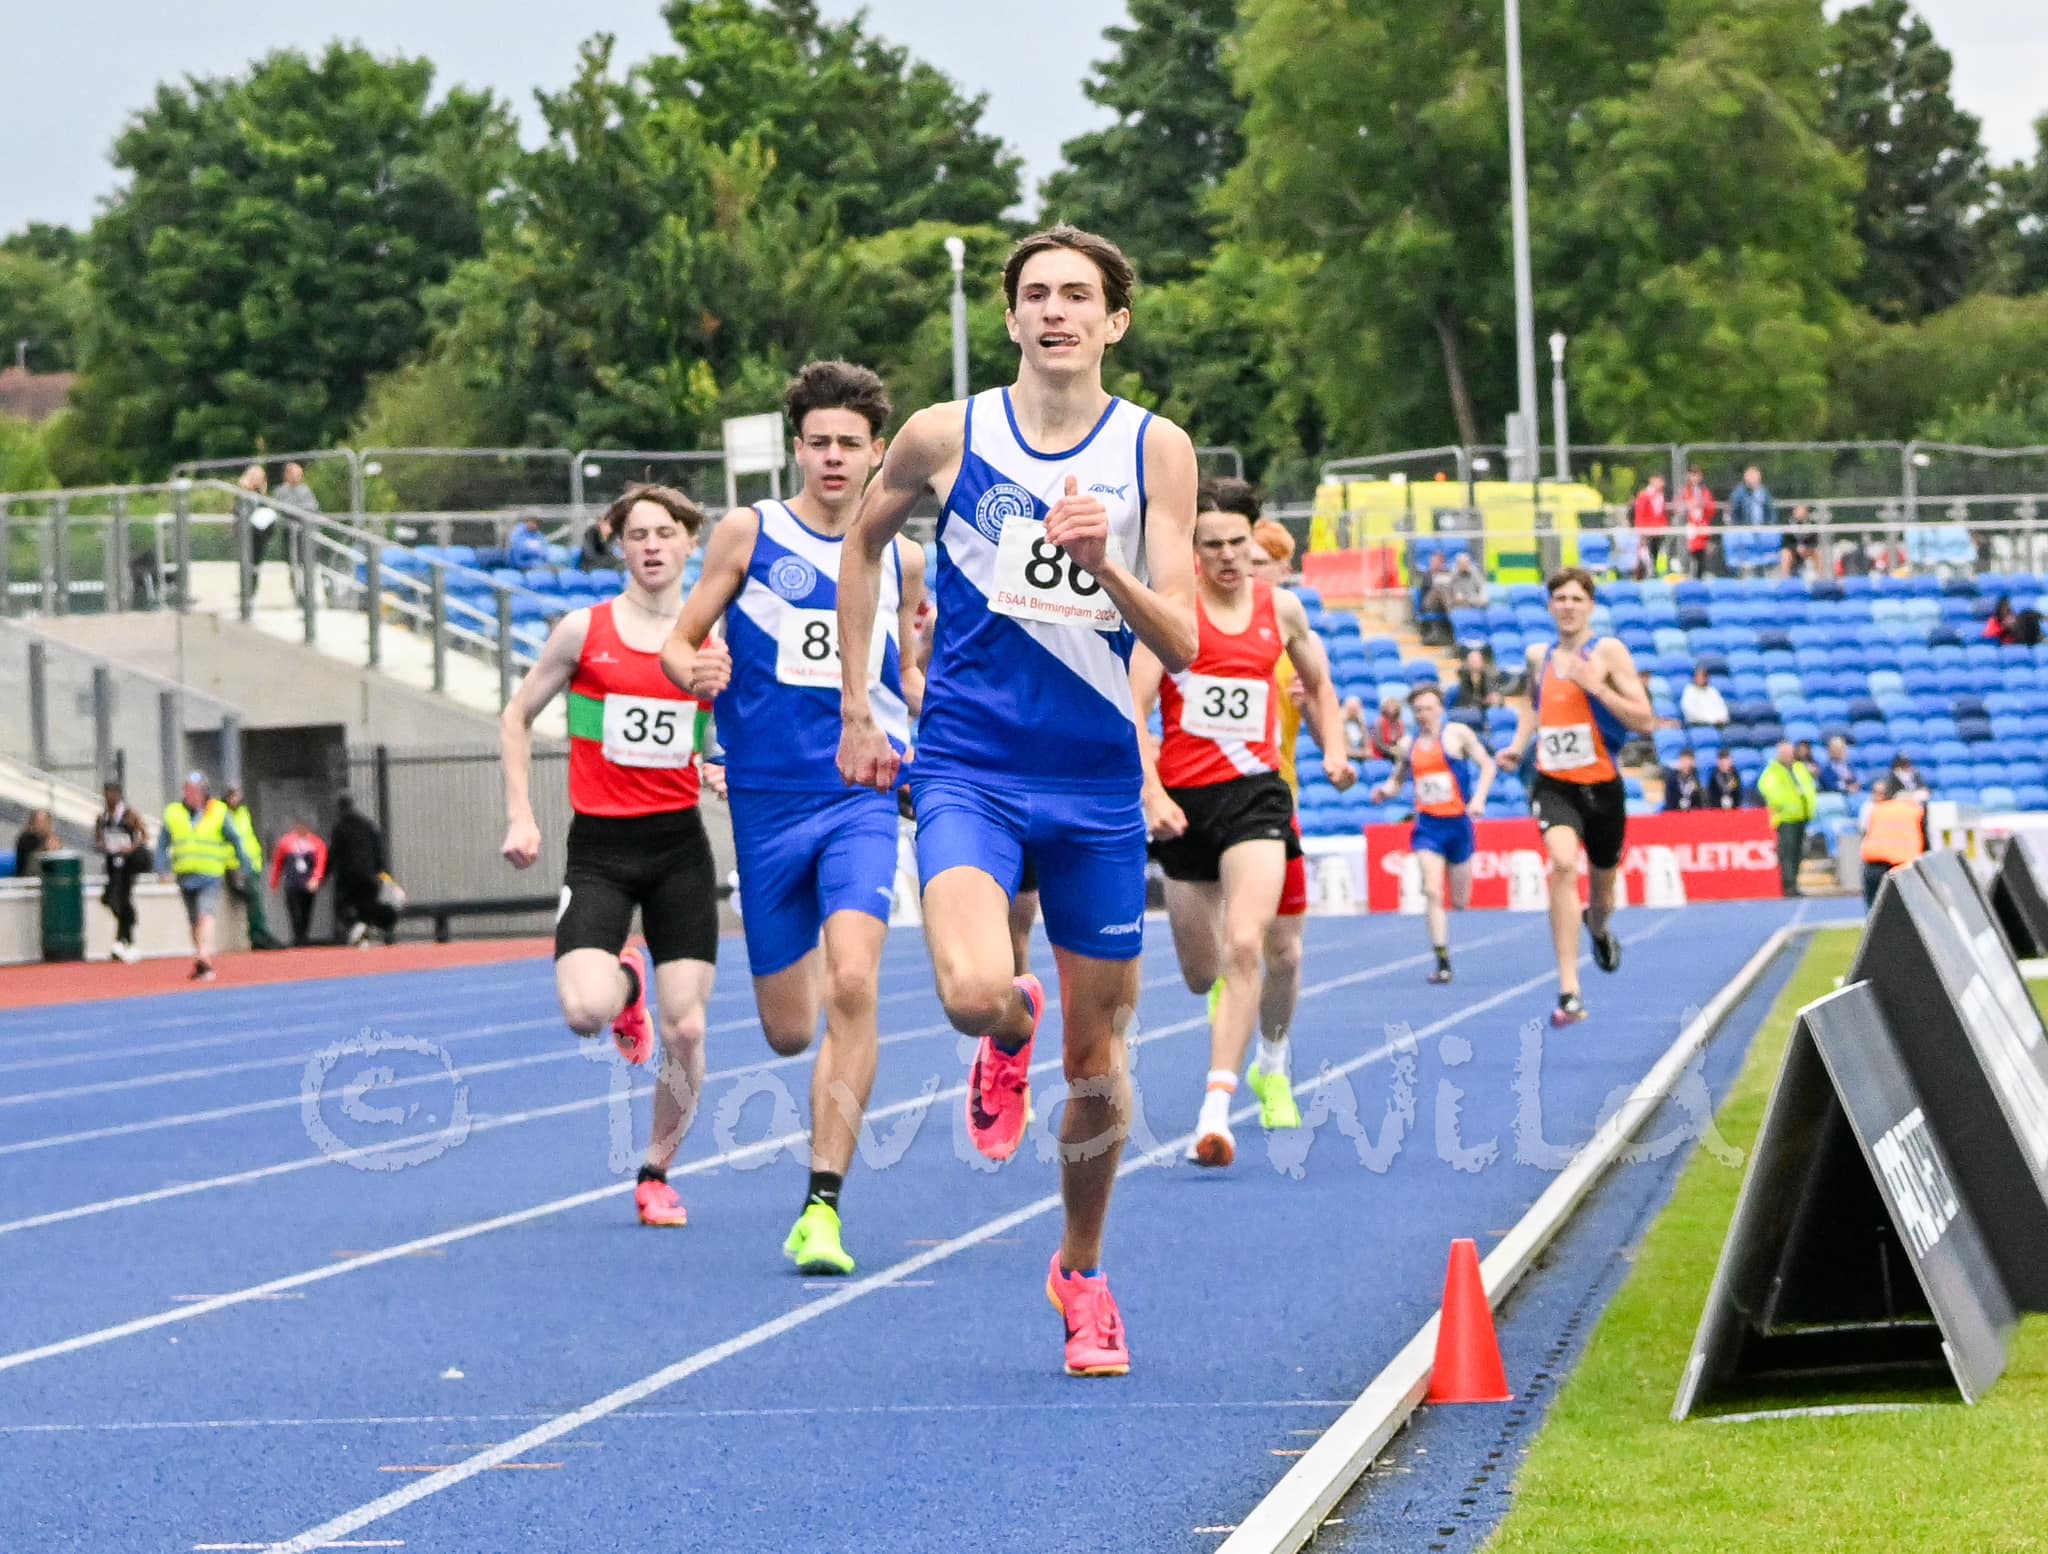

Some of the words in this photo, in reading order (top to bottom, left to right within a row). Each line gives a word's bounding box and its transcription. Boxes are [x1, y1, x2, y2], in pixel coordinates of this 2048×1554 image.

[998, 591, 1026, 607] ESAA
[1030, 597, 1092, 619] Birmingham
[1094, 610, 1118, 622] 2024
[802, 621, 840, 660] 8
[1203, 686, 1249, 719] 33
[623, 707, 677, 745] 35
[1545, 731, 1579, 756] 32
[1623, 839, 1778, 874] ALETICS
